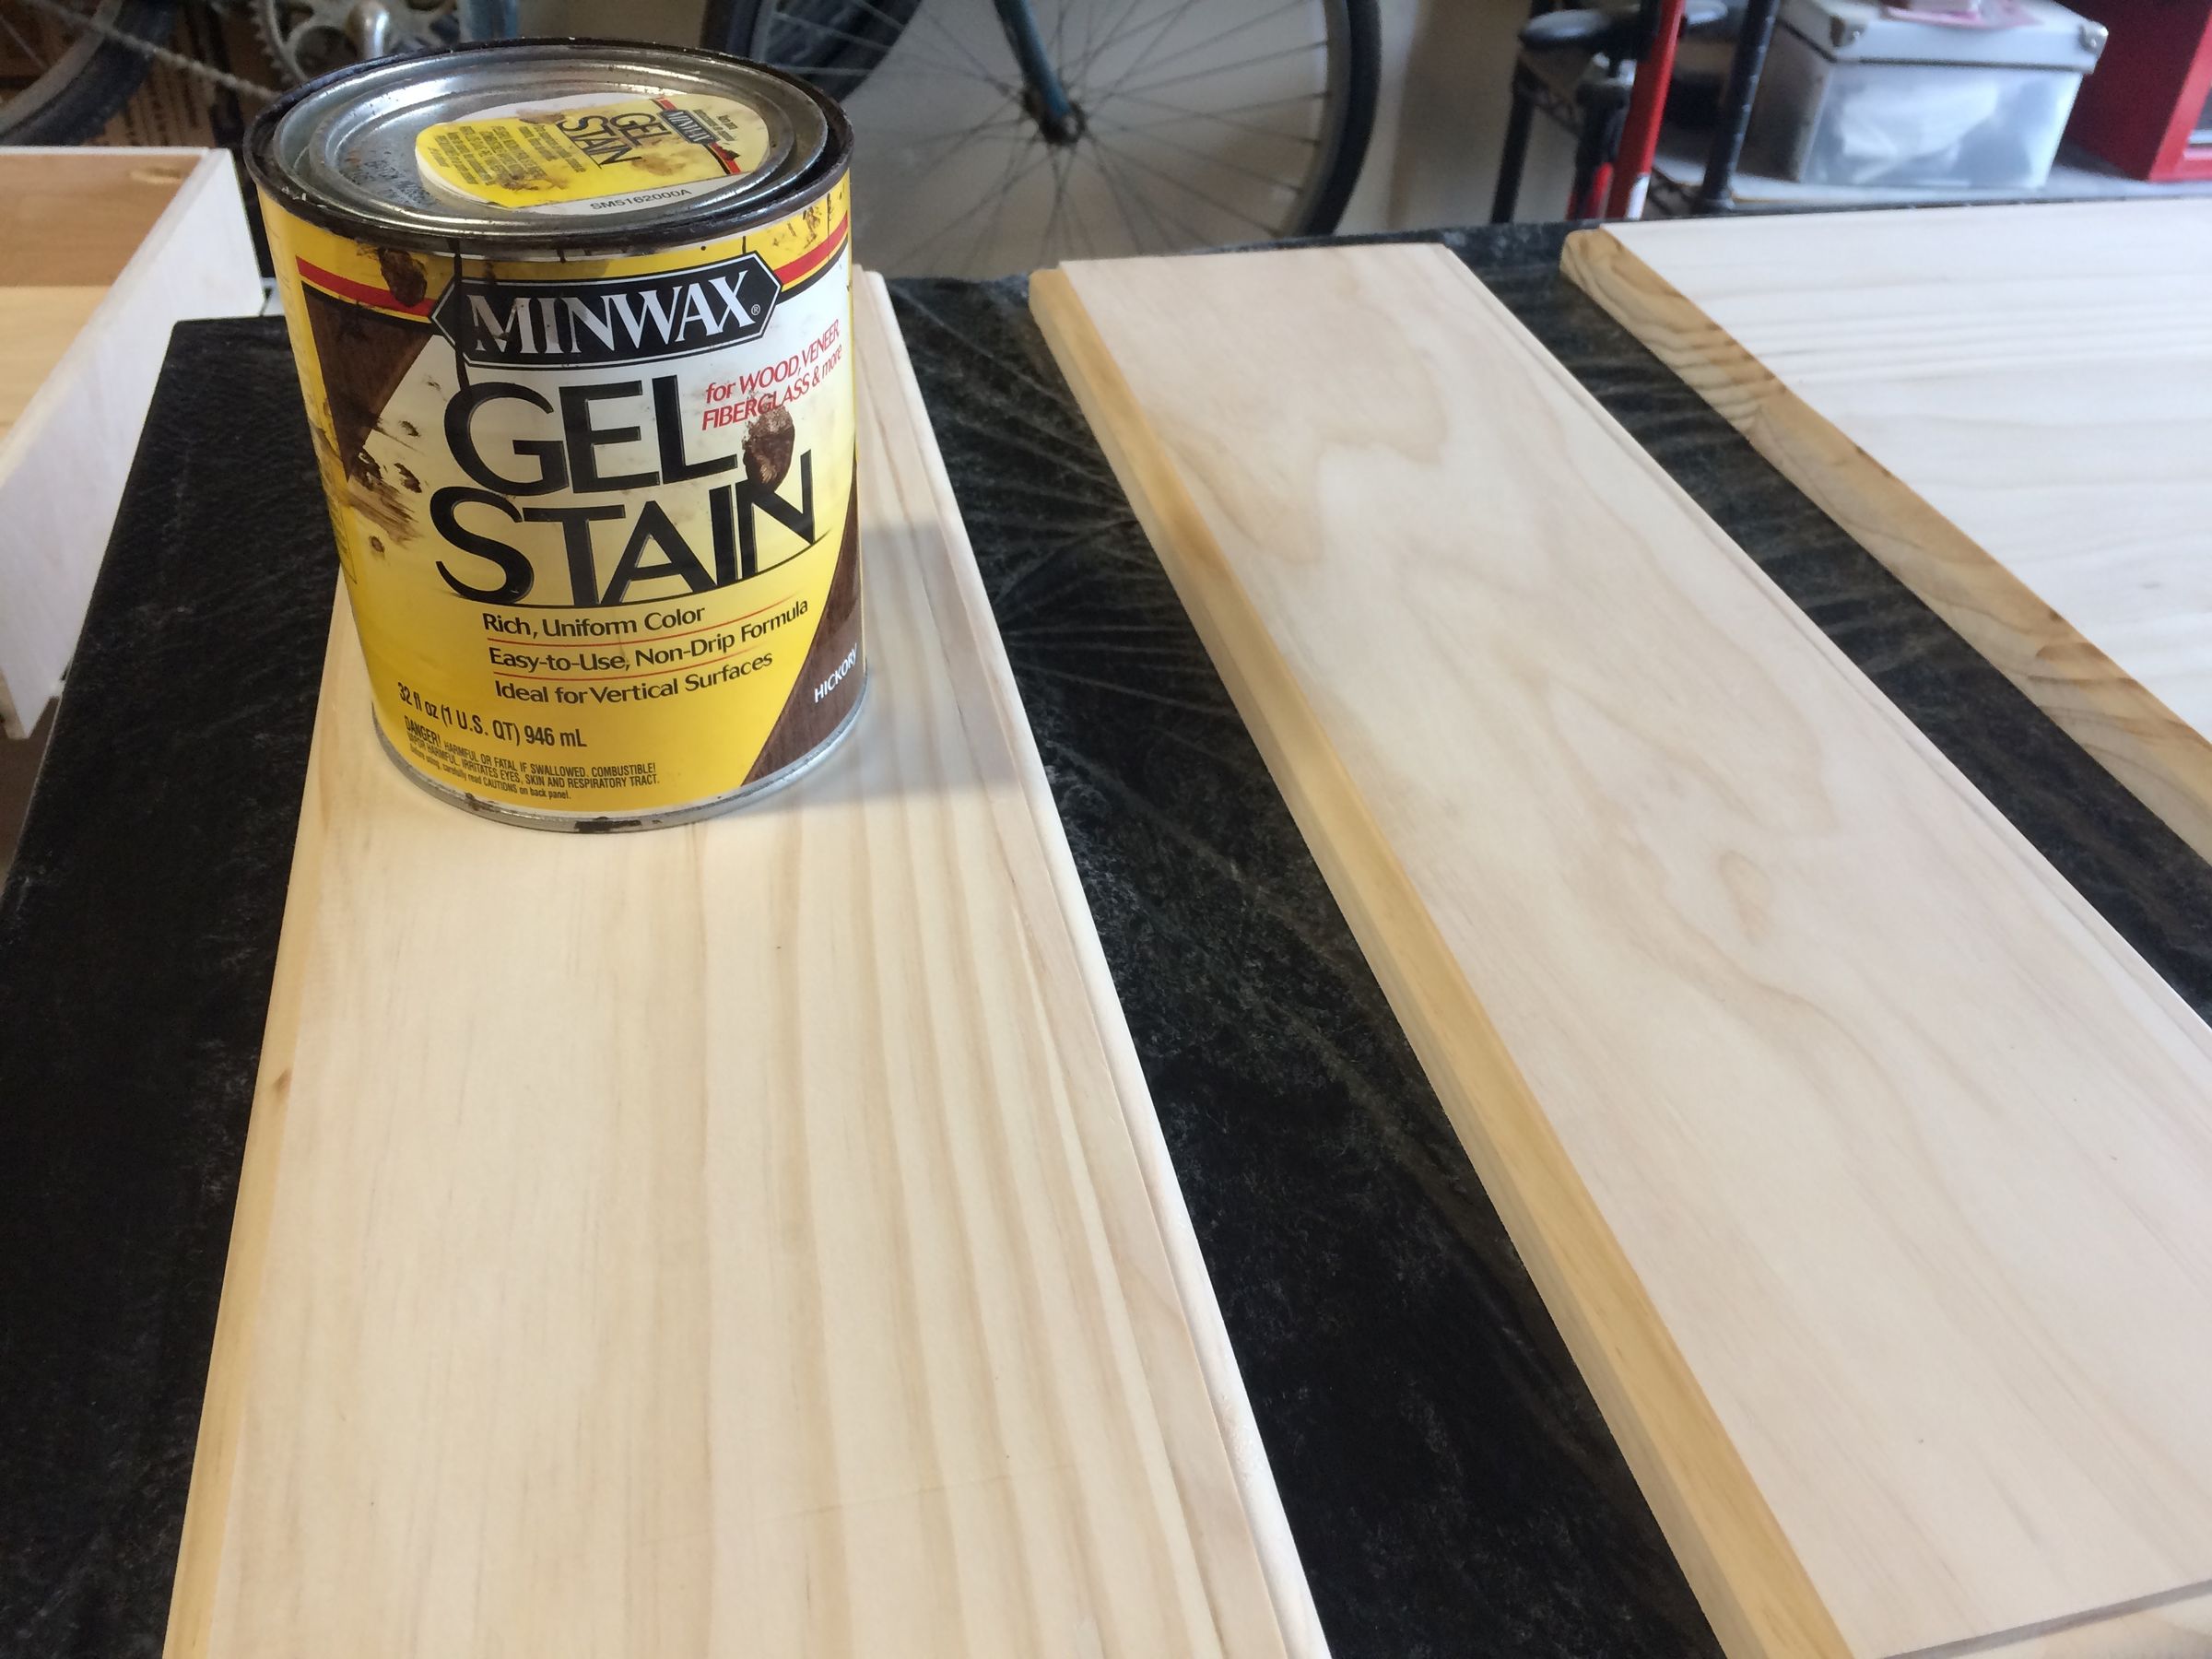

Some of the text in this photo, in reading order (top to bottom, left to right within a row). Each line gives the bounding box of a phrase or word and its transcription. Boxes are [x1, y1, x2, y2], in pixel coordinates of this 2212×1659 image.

[556, 114, 642, 168] STAIN
[609, 112, 672, 148] GEL
[590, 188, 693, 210] SM5162000A
[465, 269, 758, 355] MINWAX
[701, 345, 842, 431] FIBERGLASS & more
[705, 319, 840, 404] for WOOD, VENEER
[443, 374, 738, 497] GEL
[429, 448, 817, 606] STAIN
[482, 605, 706, 640] Rich, Uniform Color
[488, 599, 808, 672] Easy-to-Use, Non-Drip Formula
[495, 652, 773, 704] Ideal for Vertical Surfaces
[814, 642, 858, 703] HICKORY
[397, 681, 413, 706] 32
[425, 700, 440, 720] oz
[441, 704, 453, 726] (1
[456, 709, 488, 735] U.S.
[492, 719, 520, 746] QT)
[524, 725, 555, 747] 946
[559, 728, 588, 747] mL
[404, 715, 657, 778] DANGER! HARMFUL OR FATAL IF SWALLOWED. COMBUSTIBLE!
[461, 758, 499, 779] IRRITATES
[525, 774, 546, 786] SKIN
[547, 776, 565, 788] AND
[567, 777, 627, 790] RESPIRATORY
[629, 773, 661, 786] TRACT.
[482, 777, 518, 794] CAUTIONS
[520, 786, 529, 795] on
[530, 788, 547, 798] back
[548, 790, 572, 800] panel.
